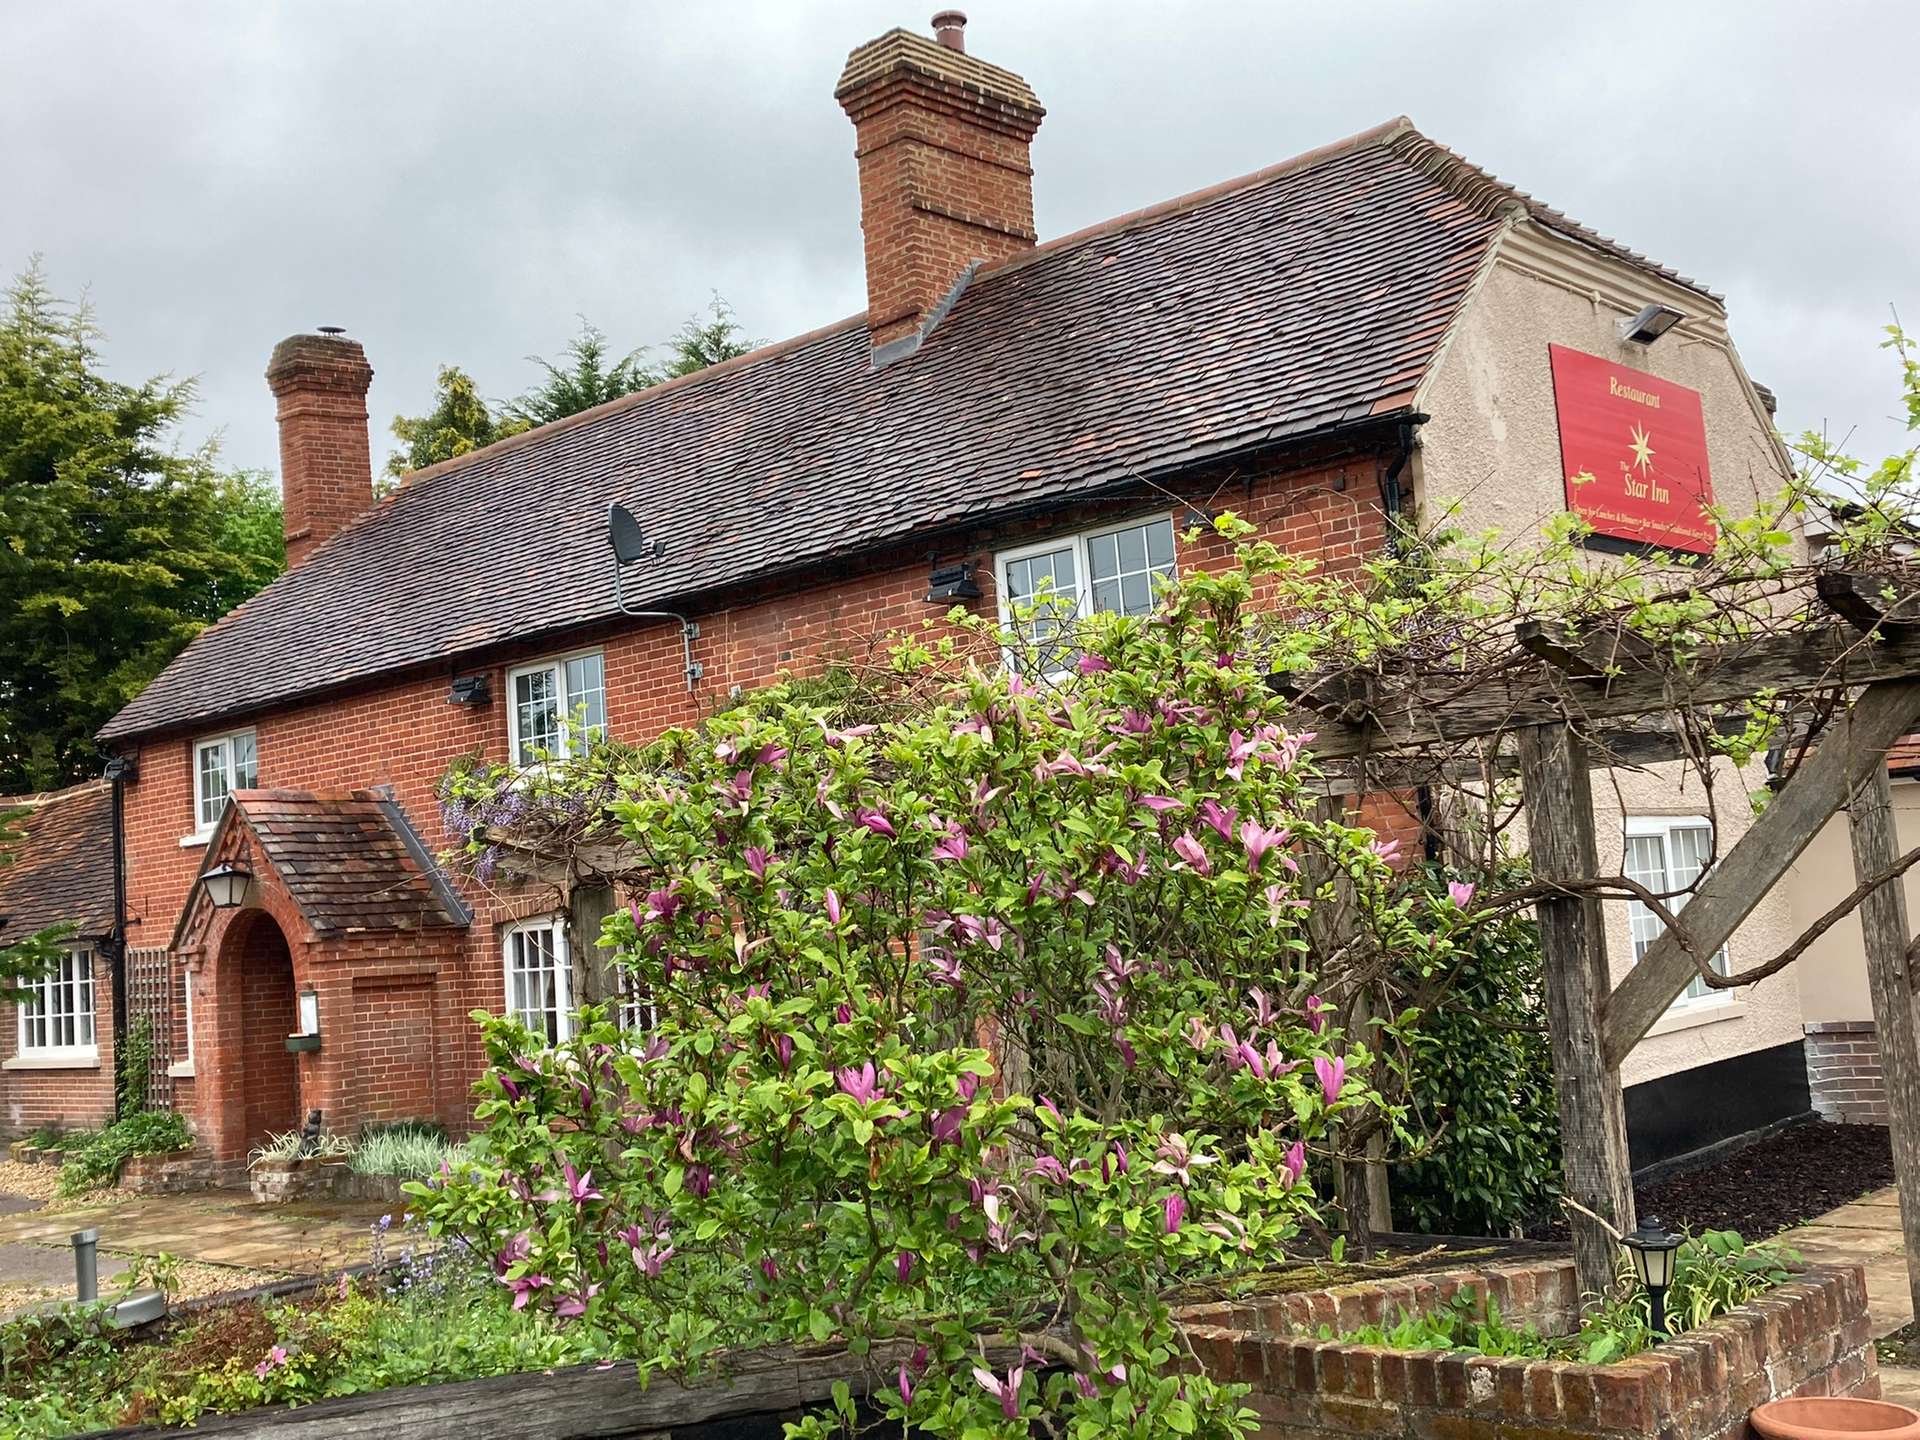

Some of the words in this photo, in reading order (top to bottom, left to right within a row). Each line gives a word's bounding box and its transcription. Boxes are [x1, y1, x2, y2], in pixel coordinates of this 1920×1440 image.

[1610, 376, 1660, 408] Restaurant
[1624, 473, 1649, 499] Star
[1651, 480, 1669, 504] Inn
